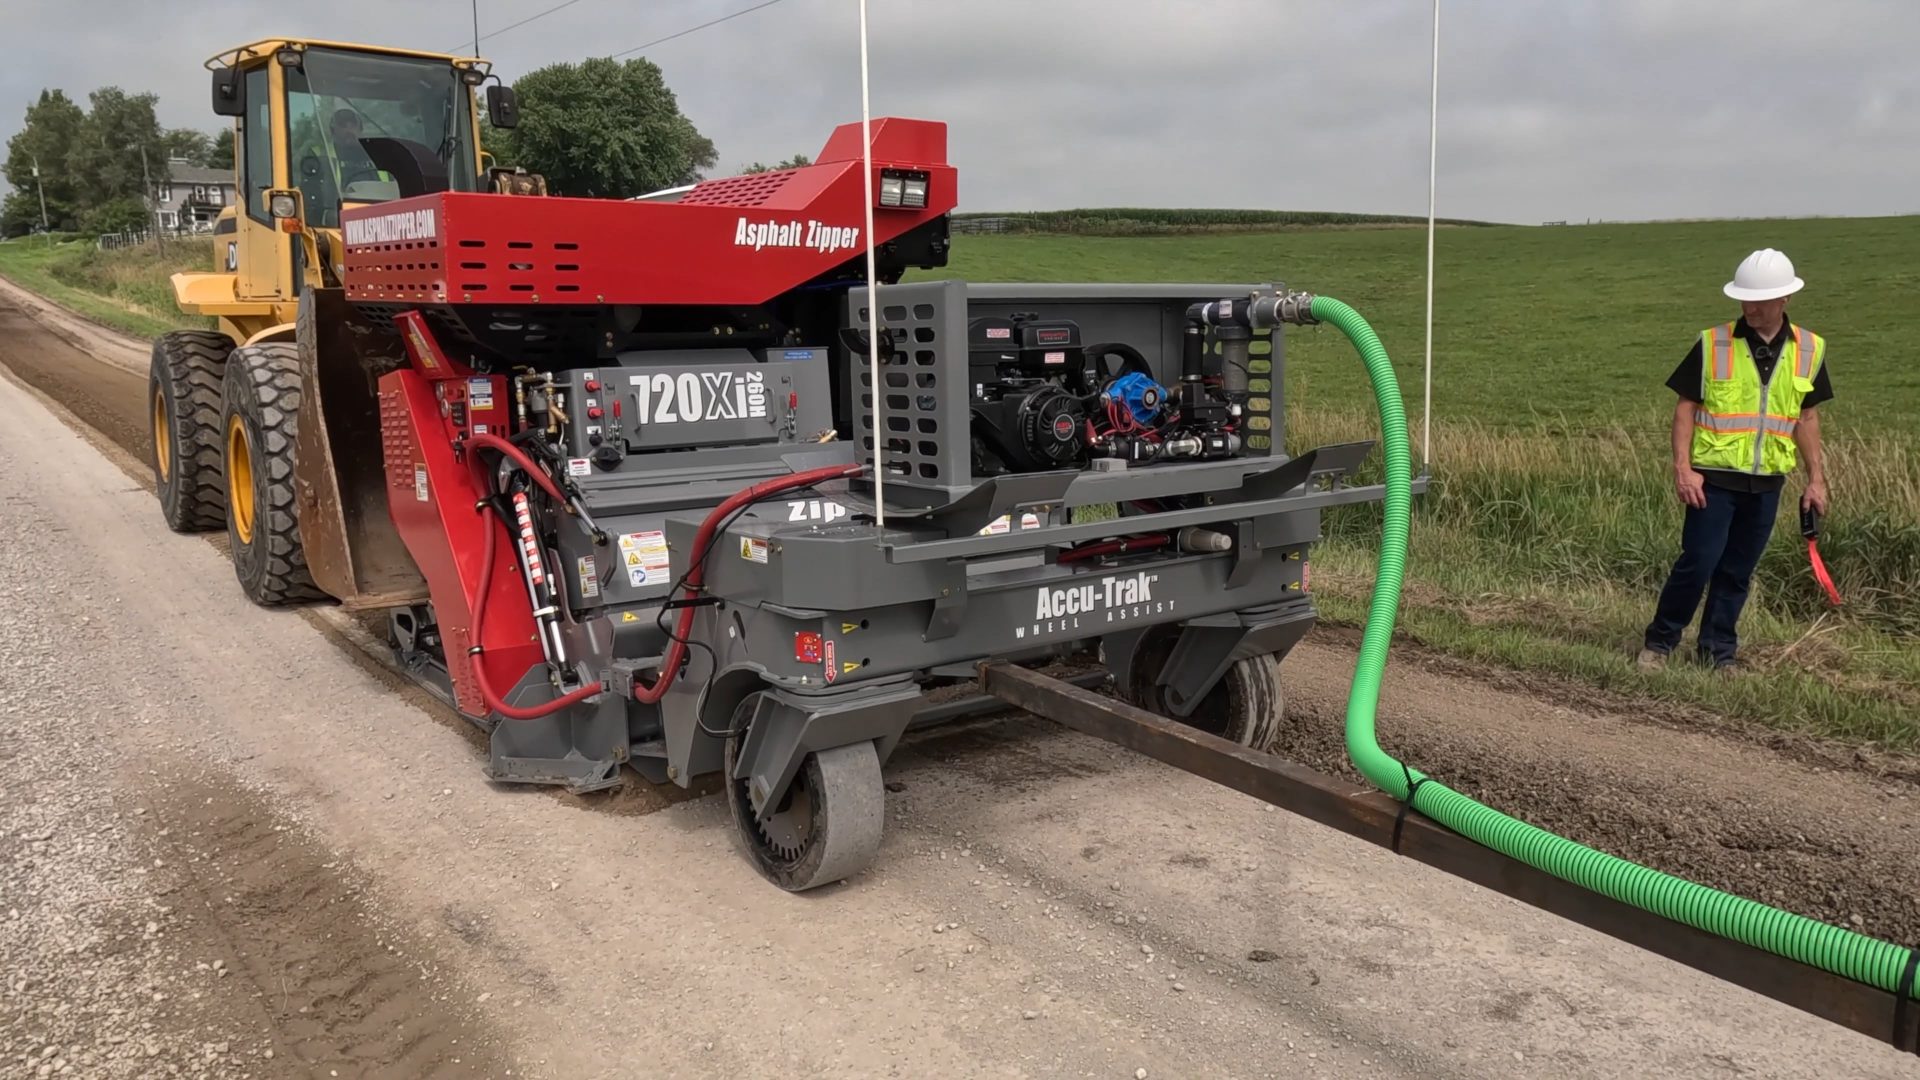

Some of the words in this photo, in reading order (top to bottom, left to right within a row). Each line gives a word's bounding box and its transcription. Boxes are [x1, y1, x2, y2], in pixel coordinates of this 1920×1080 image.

[345, 209, 436, 245] WWW.ASPHALTZIPPER.COM
[734, 217, 802, 252] Asphalt
[805, 219, 859, 254] Zipper
[1016, 618, 1079, 638] WHEEL
[1107, 600, 1175, 622] ASSIST
